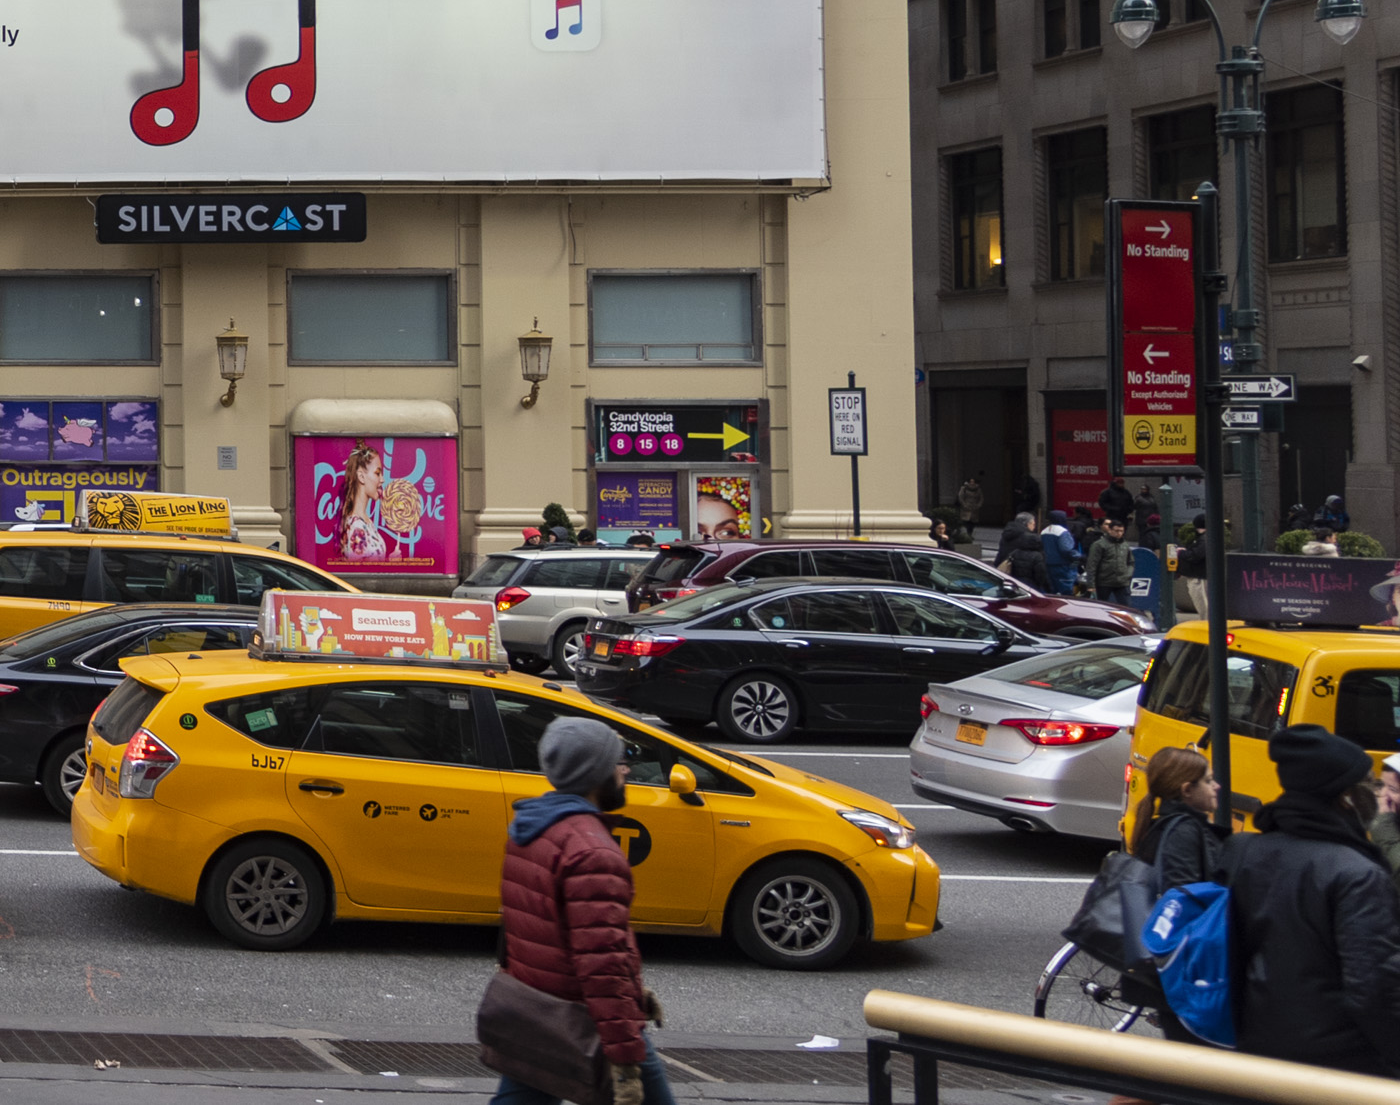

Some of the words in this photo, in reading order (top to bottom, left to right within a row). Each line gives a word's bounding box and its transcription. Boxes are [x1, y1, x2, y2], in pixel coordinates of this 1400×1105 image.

[1127, 244, 1142, 257] No
[1144, 244, 1189, 261] Standing
[1127, 371, 1142, 384] No
[1144, 371, 1191, 387] Standing
[1258, 382, 1281, 393] WAY
[1131, 390, 1152, 400] Except
[1153, 389, 1188, 399] Authorized
[834, 396, 860, 410] STOP
[1147, 401, 1172, 411] Vehicles
[609, 411, 673, 424] Candytopia
[835, 413, 849, 422] HERE
[852, 413, 860, 422] ON
[1225, 412, 1236, 422] ONE
[1241, 412, 1254, 422] WAY
[610, 421, 638, 432] 32nd
[640, 421, 674, 432] Street
[841, 424, 855, 434] RED
[1160, 423, 1183, 434] TAXI
[617, 438, 625, 449] 8
[639, 438, 653, 449] 15
[665, 438, 679, 450] 18
[836, 436, 861, 446] SIGNAL
[1158, 435, 1187, 446] Stand
[2, 468, 148, 489] Outrageously
[638, 486, 673, 494] CANDY
[147, 506, 168, 515] THE
[169, 502, 196, 516] LION
[197, 500, 226, 514] KING
[1281, 605, 1301, 613] prime
[357, 616, 411, 627] seamless
[344, 633, 363, 641] HOW
[365, 634, 383, 642] NEW
[384, 635, 405, 643] YORK
